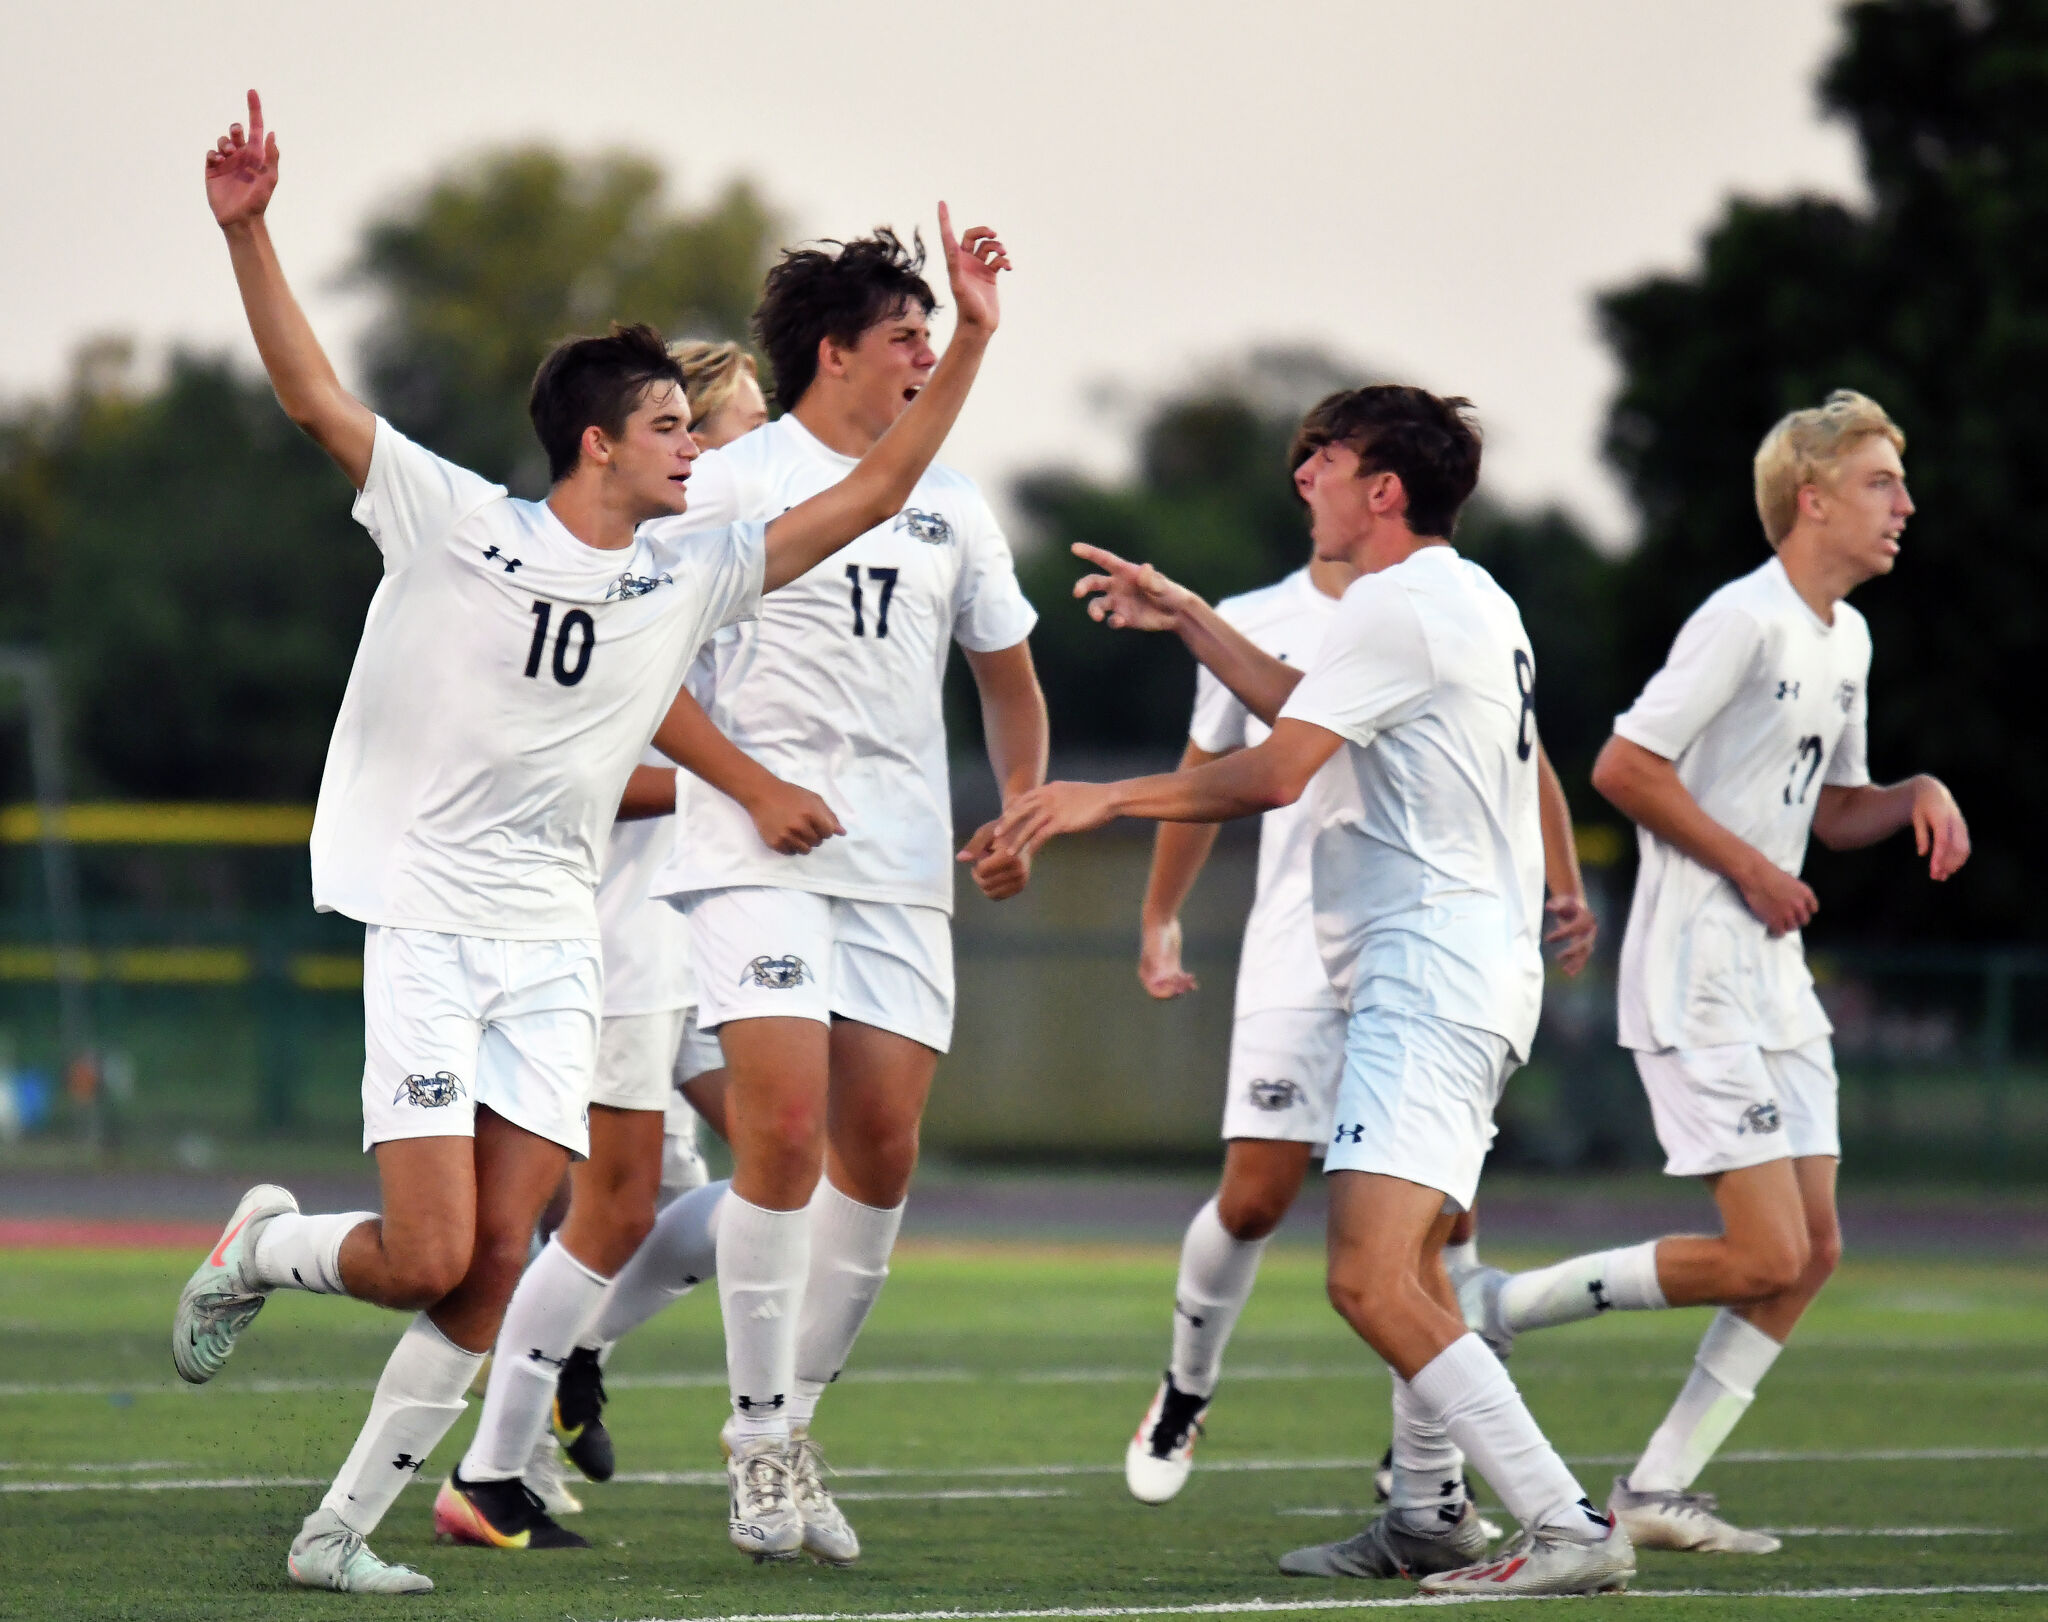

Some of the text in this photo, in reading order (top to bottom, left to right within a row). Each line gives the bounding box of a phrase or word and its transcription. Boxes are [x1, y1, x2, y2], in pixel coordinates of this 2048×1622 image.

[523, 600, 596, 687] 10
[845, 563, 899, 639] 17
[1513, 648, 1537, 762] 8
